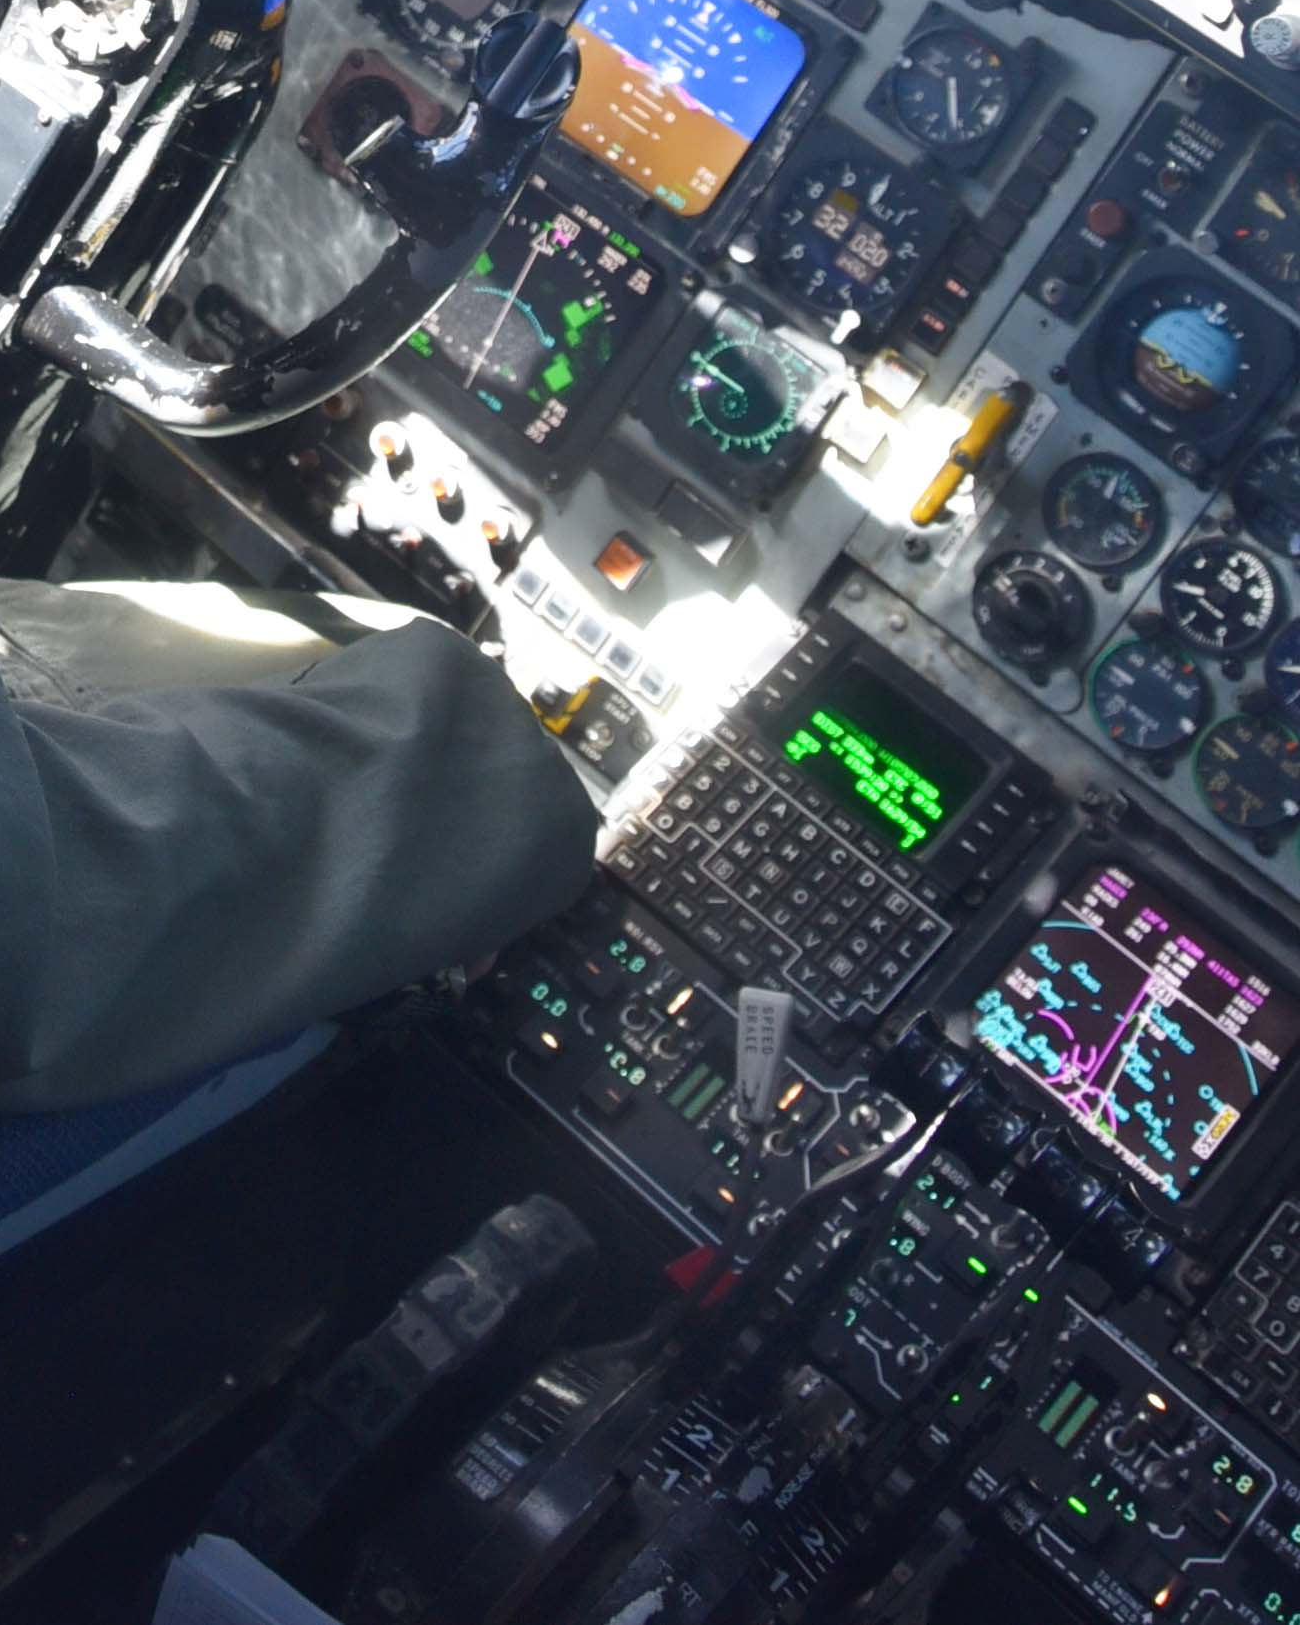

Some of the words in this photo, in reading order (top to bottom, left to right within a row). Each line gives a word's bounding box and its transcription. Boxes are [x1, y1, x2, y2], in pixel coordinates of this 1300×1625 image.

[813, 204, 849, 241] 32
[713, 755, 731, 772] 2
[742, 778, 760, 794] 3
[771, 803, 787, 819] A
[657, 814, 674, 830] 0
[754, 822, 770, 838] G
[800, 825, 817, 841] B
[732, 840, 751, 859] M
[781, 844, 800, 862] H
[830, 848, 847, 865] C
[746, 884, 762, 900] T
[841, 896, 857, 908] J
[774, 910, 791, 925] U
[822, 912, 838, 925] P
[869, 916, 887, 934] K
[918, 919, 936, 933] F
[804, 933, 821, 948] V
[852, 937, 868, 955] Q
[900, 941, 912, 958] L
[802, 967, 816, 981] Y
[881, 961, 899, 979] R
[827, 991, 846, 1009] Z
[862, 983, 880, 1000] X
[762, 1006, 774, 1055] SPEED
[941, 1162, 972, 1191] BODY
[903, 1210, 931, 1237] WING
[1270, 1244, 1285, 1260] 4
[1254, 1266, 1270, 1281] 7
[686, 1425, 714, 1450] 2
[661, 1469, 681, 1492] 1
[1212, 1455, 1254, 1494] 2.8
[802, 1528, 825, 1556] 2
